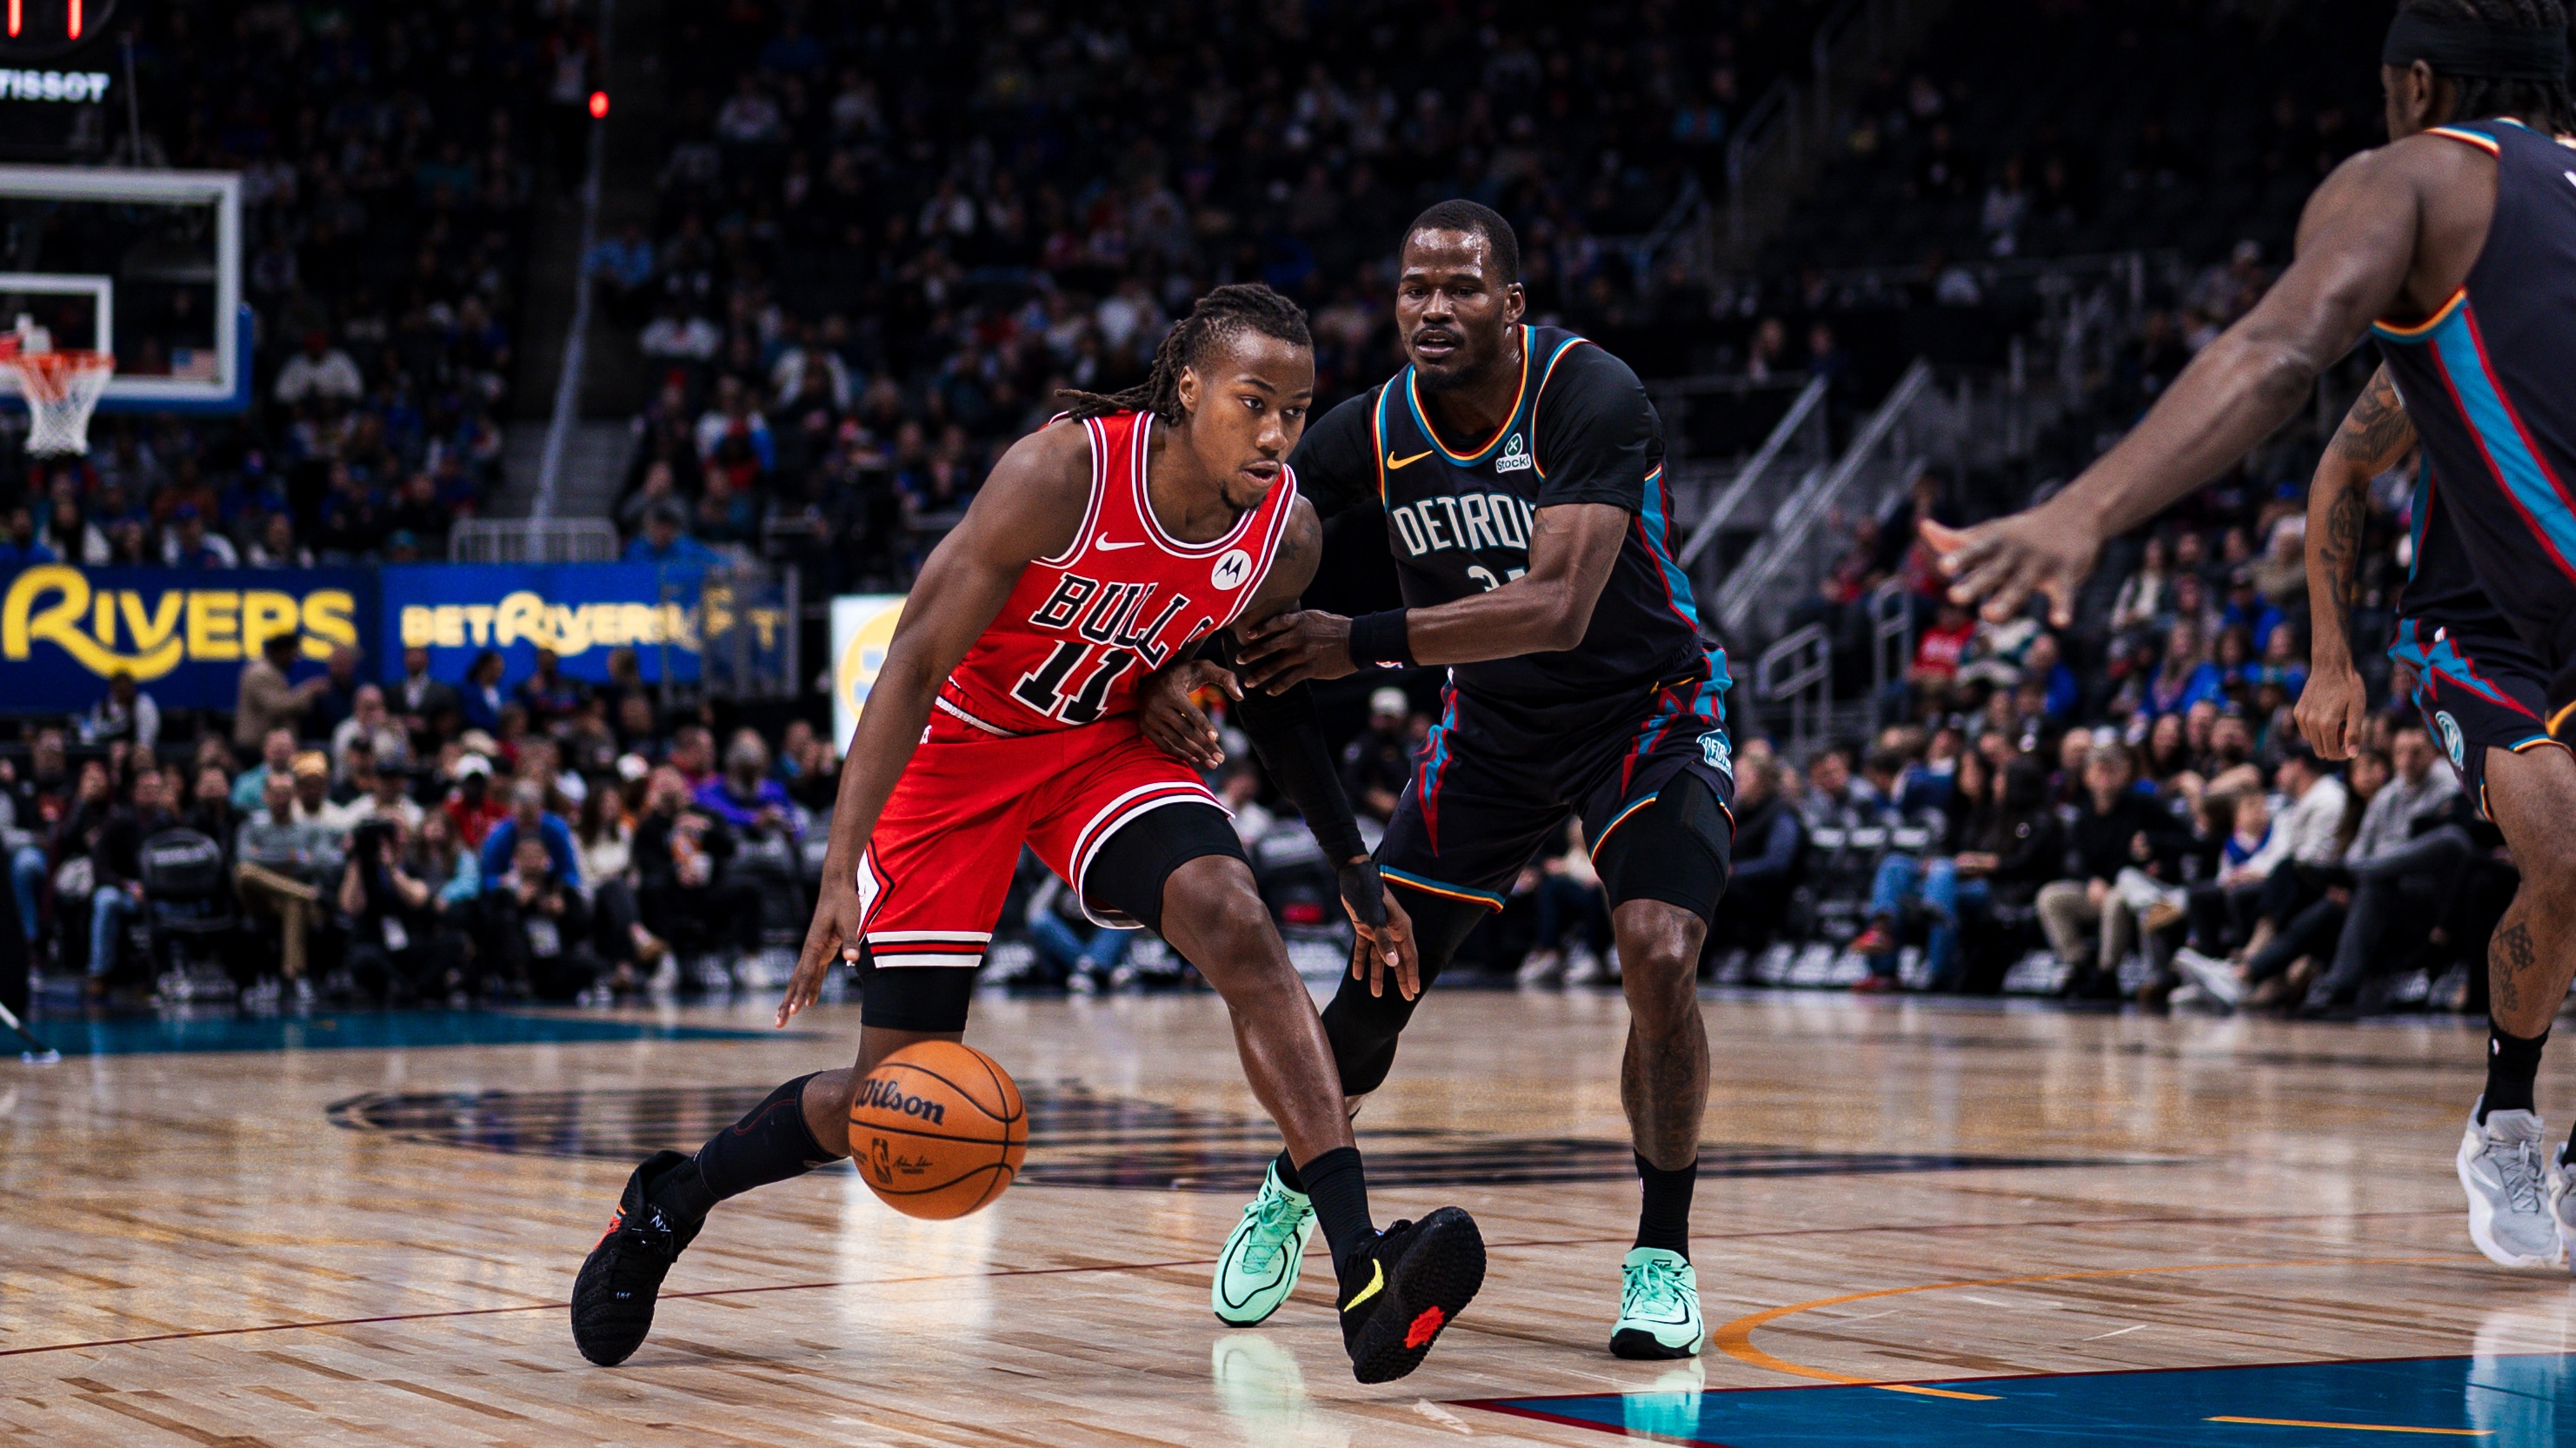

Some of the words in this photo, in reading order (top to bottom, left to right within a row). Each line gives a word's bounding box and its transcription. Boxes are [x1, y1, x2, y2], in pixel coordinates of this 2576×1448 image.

[1392, 492, 1536, 556] DETROI
[2, 565, 357, 681] RIVERS
[1009, 640, 1138, 726] 11
